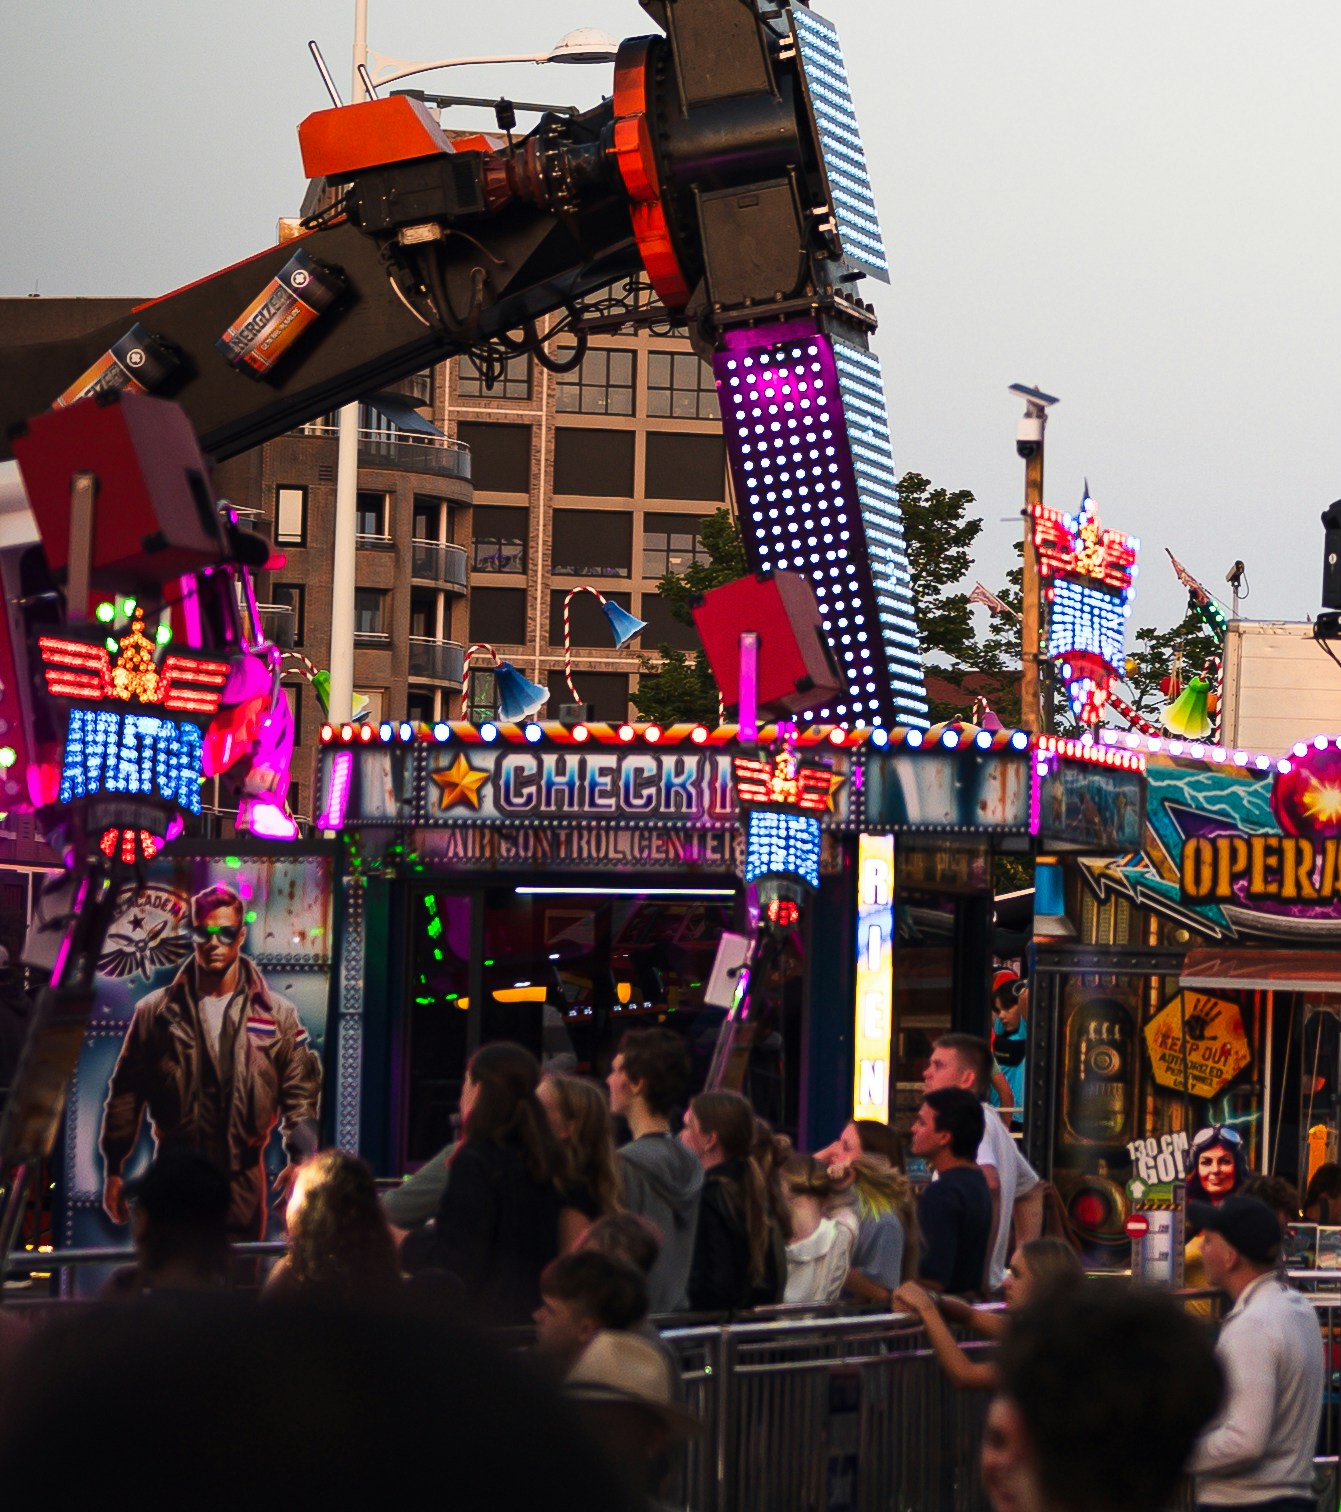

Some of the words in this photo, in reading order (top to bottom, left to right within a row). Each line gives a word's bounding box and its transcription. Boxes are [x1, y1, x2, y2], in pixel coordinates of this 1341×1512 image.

[499, 753, 701, 813] CHECK
[447, 828, 494, 859] AIR
[499, 828, 624, 860] CONTROL
[1202, 1042, 1232, 1067] OUT
[1126, 1137, 1158, 1161] 130
[1160, 1130, 1189, 1154] CM
[1138, 1150, 1186, 1186] GO!
